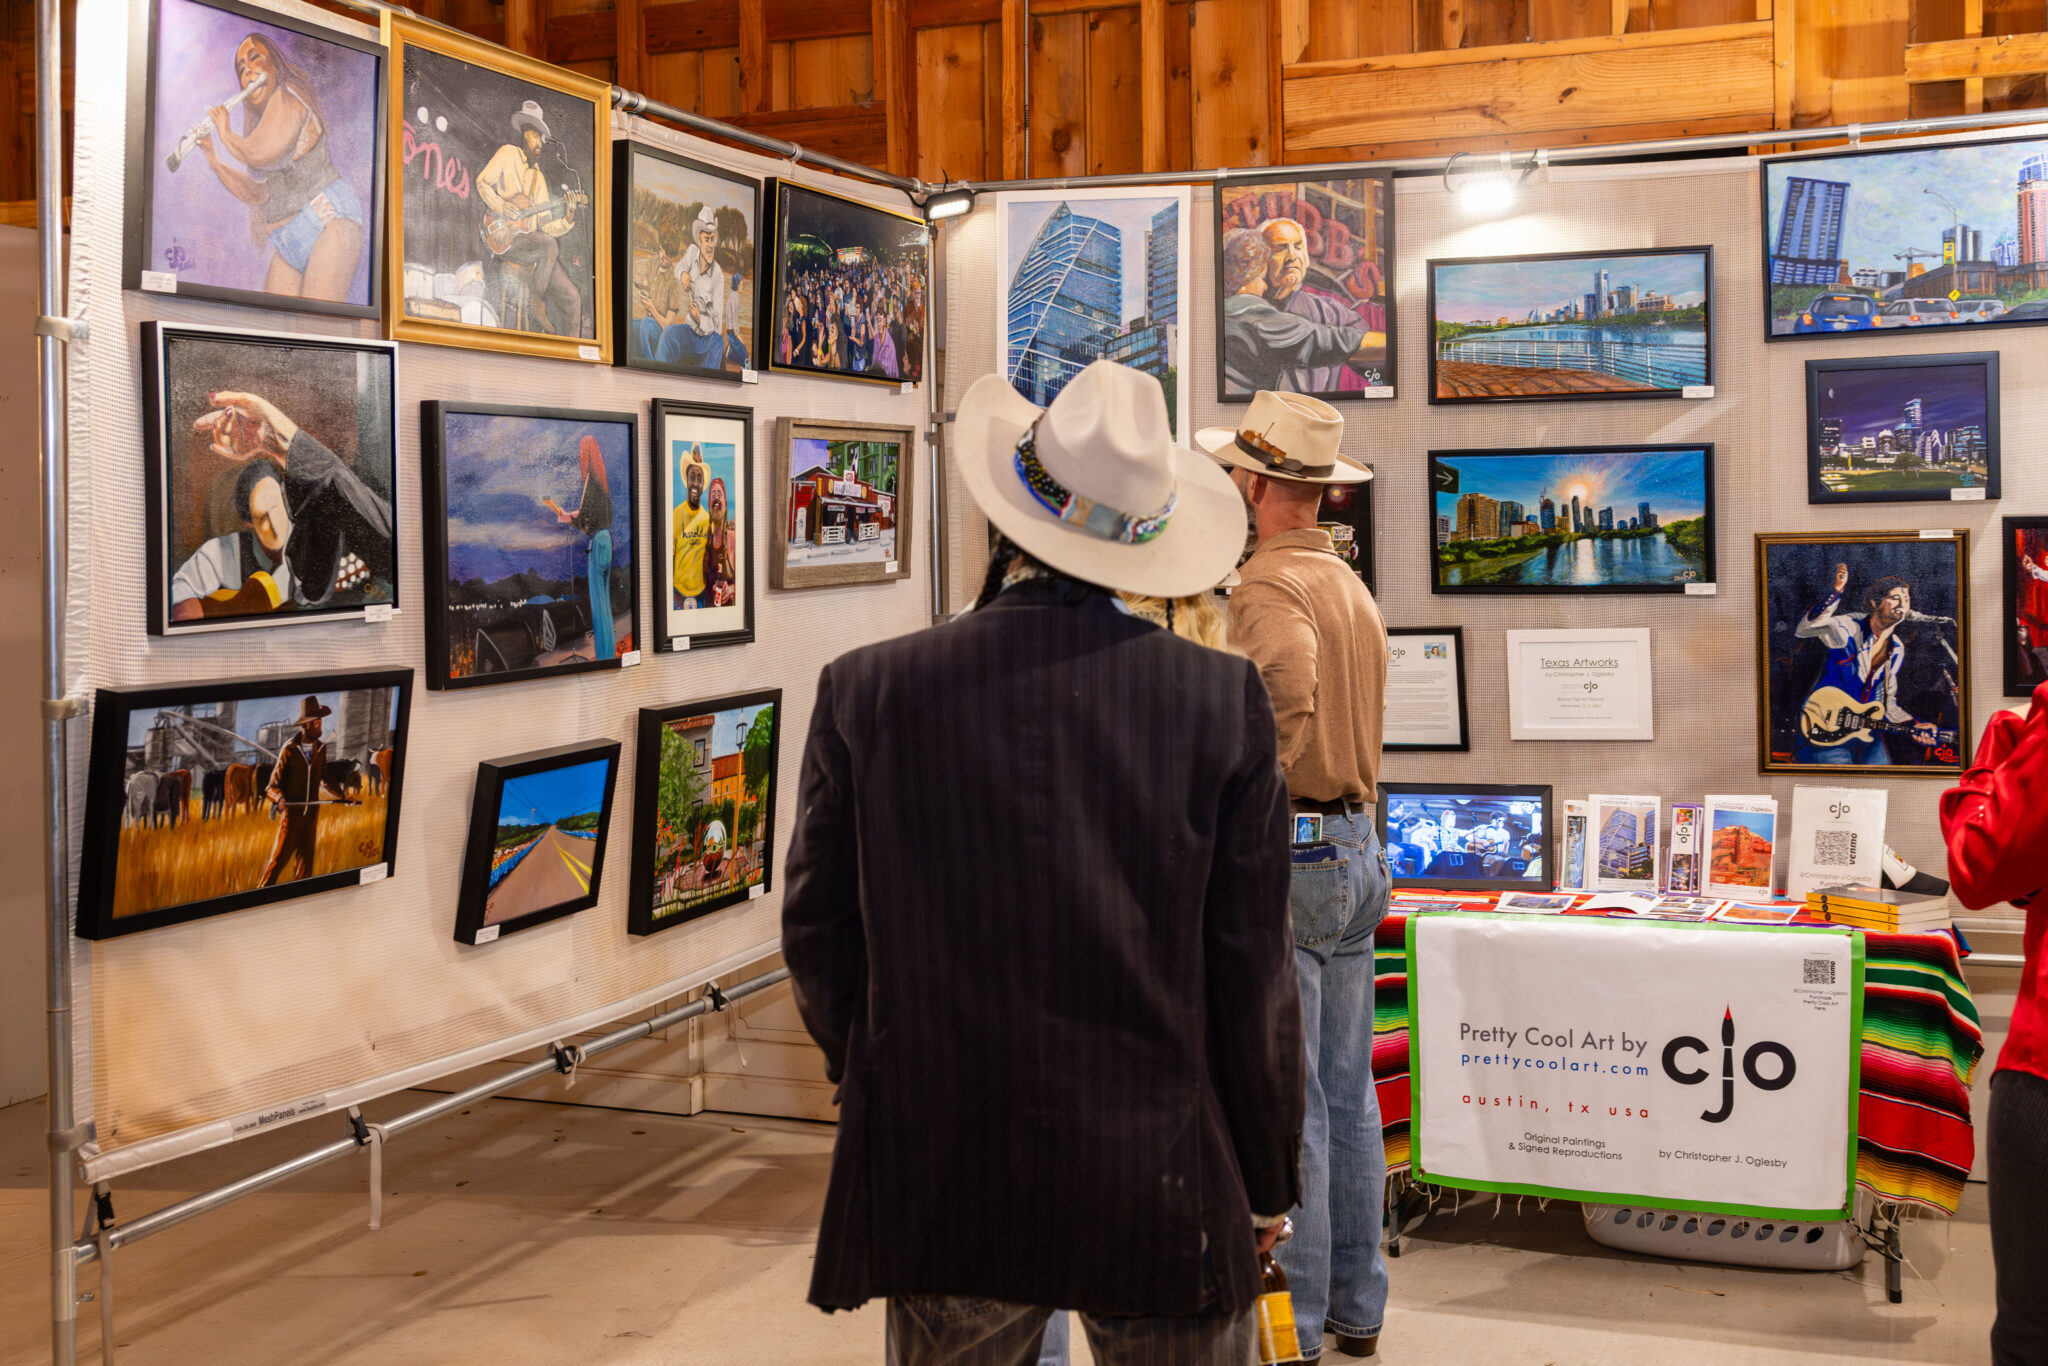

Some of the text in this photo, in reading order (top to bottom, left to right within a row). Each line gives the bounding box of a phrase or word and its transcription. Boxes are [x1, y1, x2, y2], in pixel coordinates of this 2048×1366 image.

[1392, 647, 1406, 660] cjo
[1540, 657, 1619, 669] Texas Artworks
[1583, 680, 1598, 694] cjo
[1829, 800, 1850, 819] cjo
[1676, 826, 1691, 844] cjo
[1849, 832, 1858, 866] venmo
[1460, 1022, 1648, 1059] Pretty Cool Art by
[1461, 1053, 1649, 1077] prettycoolart.com
[1661, 1001, 1797, 1124] cjo
[258, 1107, 296, 1126] MeshPanels
[1462, 1095, 1649, 1119] austin, tx usa
[1524, 1132, 1606, 1150] Original Paintings
[1508, 1142, 1623, 1161] & Signed Reproductions
[1659, 1149, 1788, 1169] by Christopher J. Oglesby
